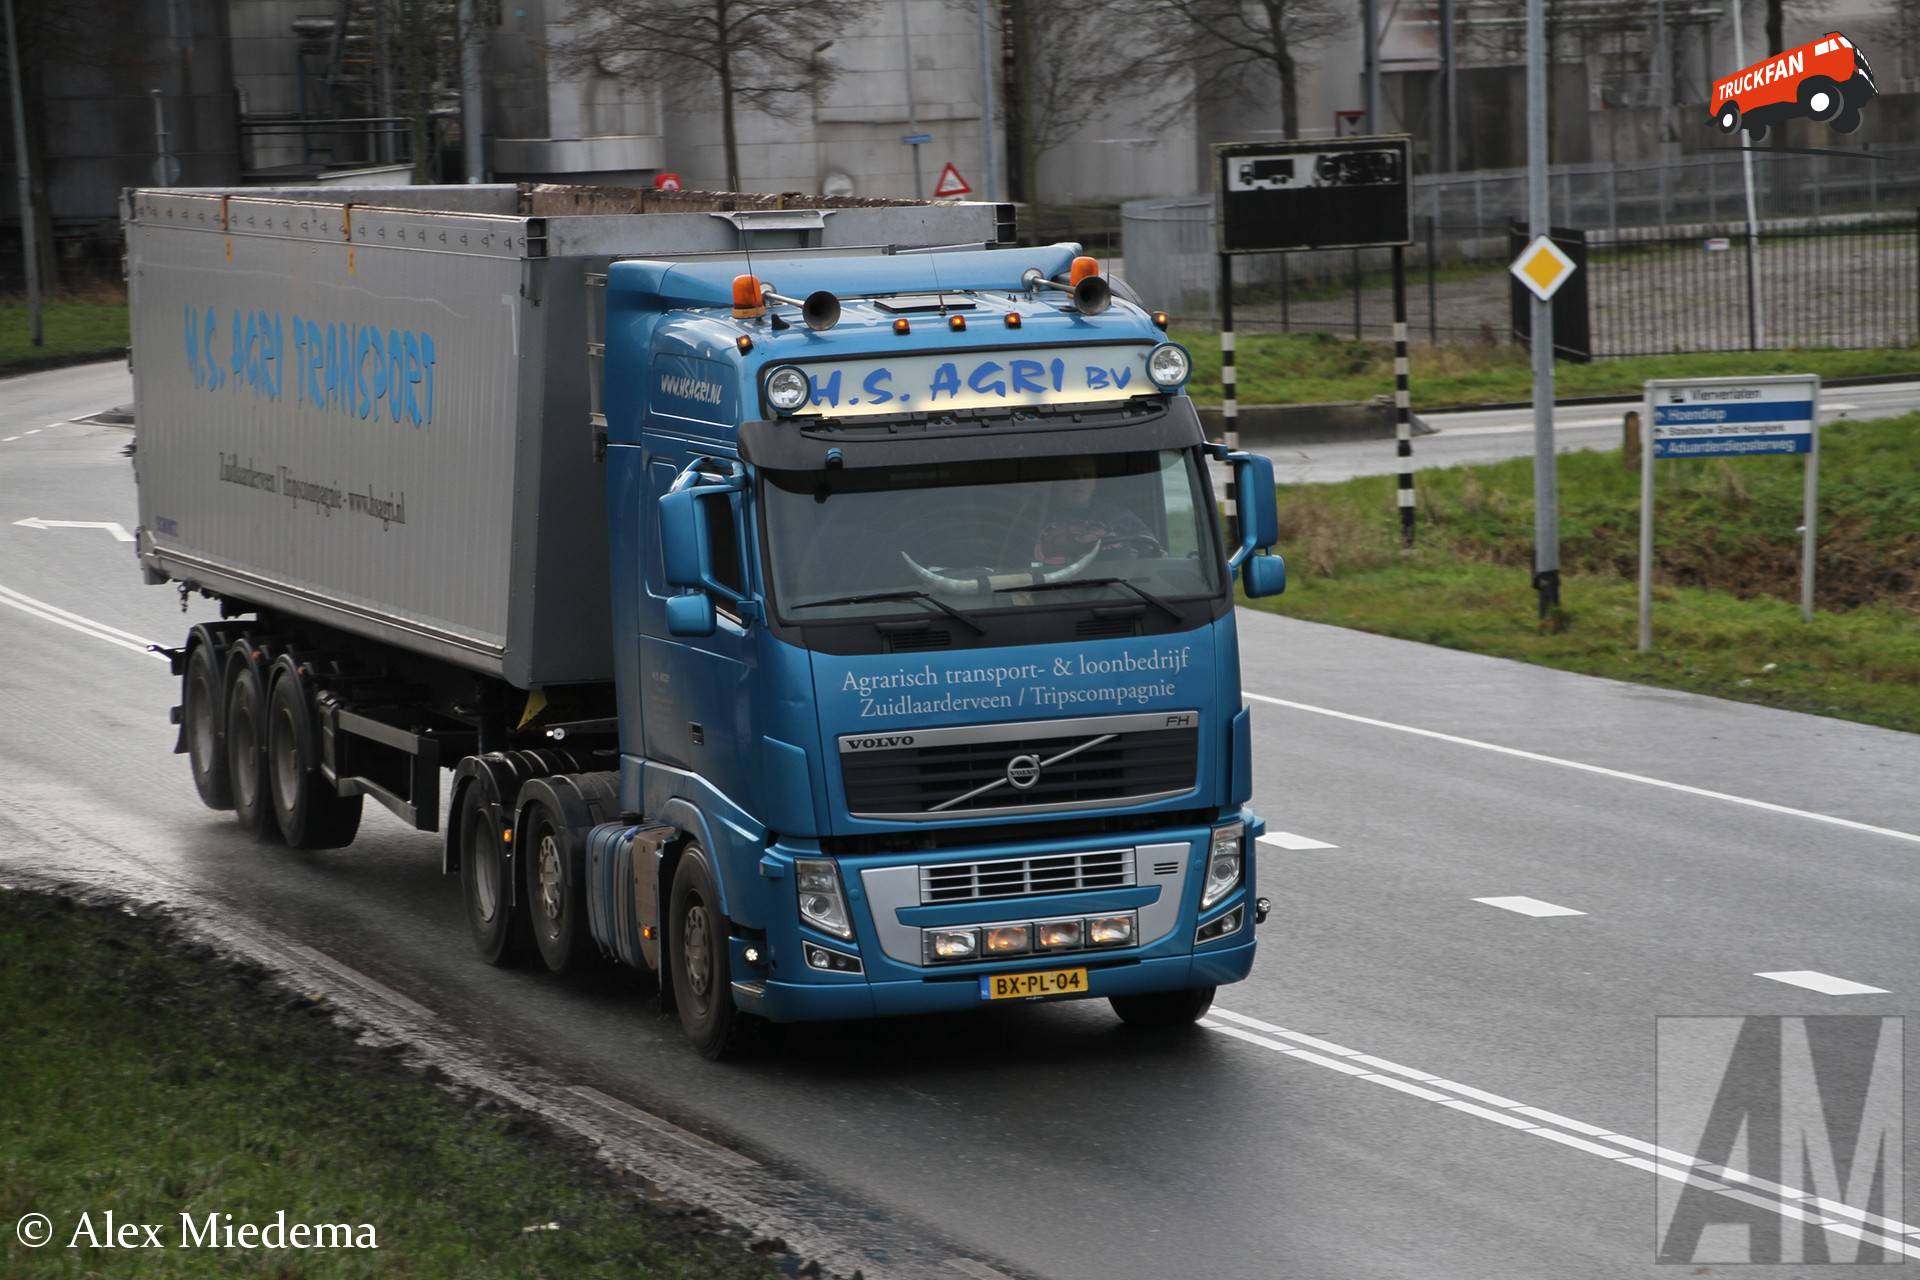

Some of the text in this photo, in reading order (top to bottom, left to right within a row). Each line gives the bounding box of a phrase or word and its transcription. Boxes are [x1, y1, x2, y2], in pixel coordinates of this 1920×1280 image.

[231, 308, 284, 403] AGRI
[293, 315, 436, 430] TRANSPORT
[810, 358, 1132, 409] H.S. AGRI BV
[841, 646, 1191, 697] Agrarisch transport- & loonbedrijf
[860, 679, 1176, 718] Zuidlaarderveen / Tripscompagnie
[1165, 715, 1190, 727] FH
[846, 735, 915, 750] VOLVO
[996, 972, 1081, 995] BX-PL-04
